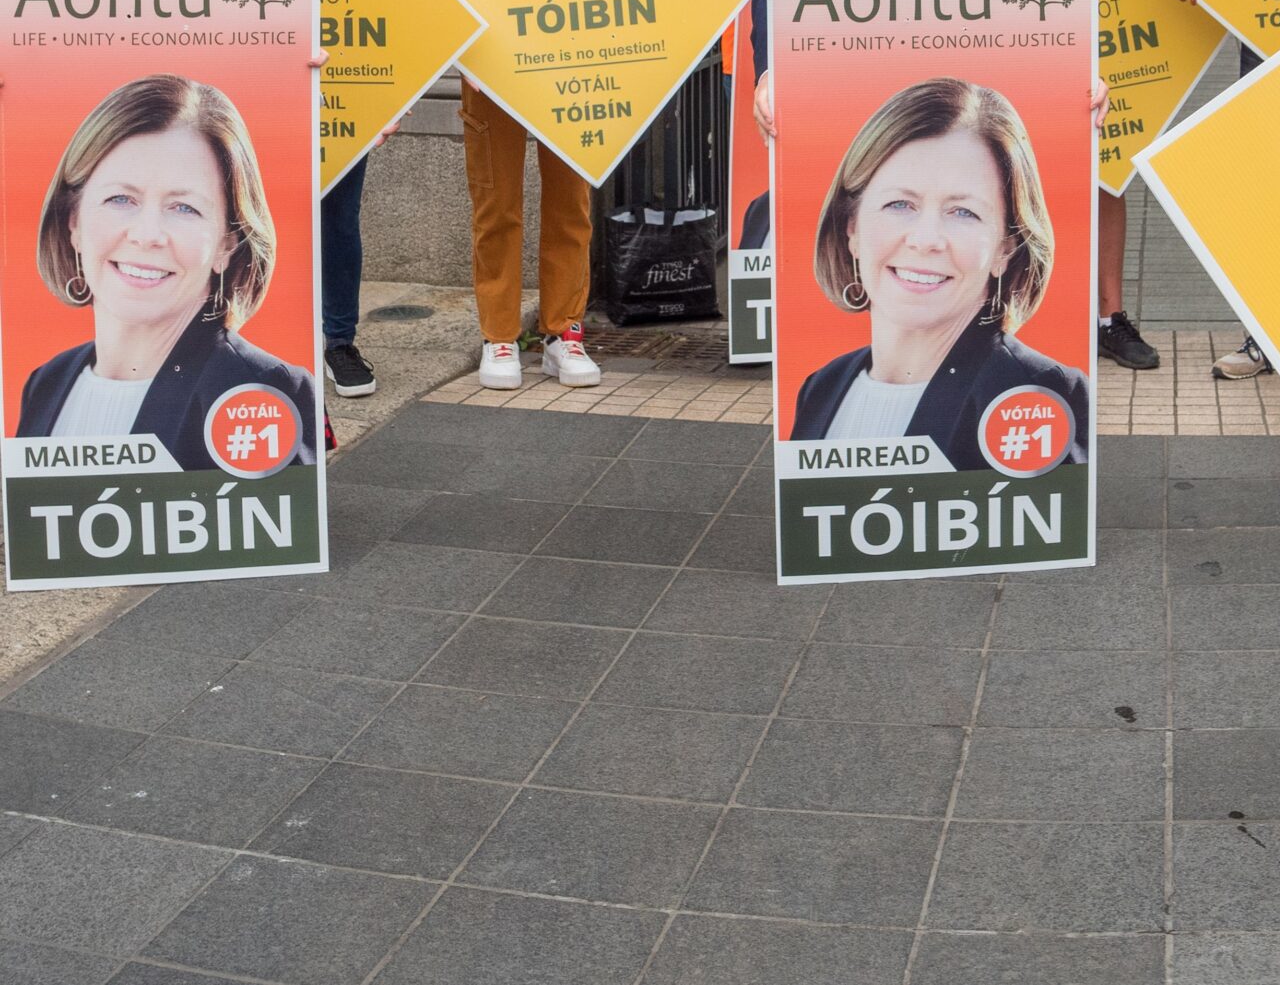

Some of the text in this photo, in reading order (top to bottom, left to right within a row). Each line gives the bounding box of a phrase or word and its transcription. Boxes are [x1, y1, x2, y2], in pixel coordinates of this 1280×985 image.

[13, 30, 296, 47] LIFE UNITY ECONOMIC JUSTICE
[320, 10, 386, 47] BÍN
[1098, 20, 1159, 58] BÍN
[514, 40, 666, 66] There is no question!
[791, 32, 1076, 52] LIFE UNITY ECONOMIC JUSTICE
[326, 64, 393, 78] question!
[1109, 61, 1169, 84] question!
[556, 76, 620, 95] VÓTÁIL
[322, 92, 346, 109] ÁIL
[552, 99, 632, 124] TÓÍBÍN
[1107, 98, 1132, 113] ÁIL
[320, 117, 355, 137] BÍN
[580, 130, 604, 147] #1
[1099, 146, 1121, 163] #1
[642, 263, 695, 289] finest
[226, 402, 282, 420] VÓTÁIL
[1001, 406, 1055, 421] VÓTÁIL
[226, 424, 279, 460] #1
[1000, 424, 1052, 460] #1
[24, 442, 156, 468] MAIREAD
[799, 444, 930, 470] MAIREAD
[30, 481, 293, 560] TÓIBÍN
[803, 481, 1062, 557] TÓIBÍN
